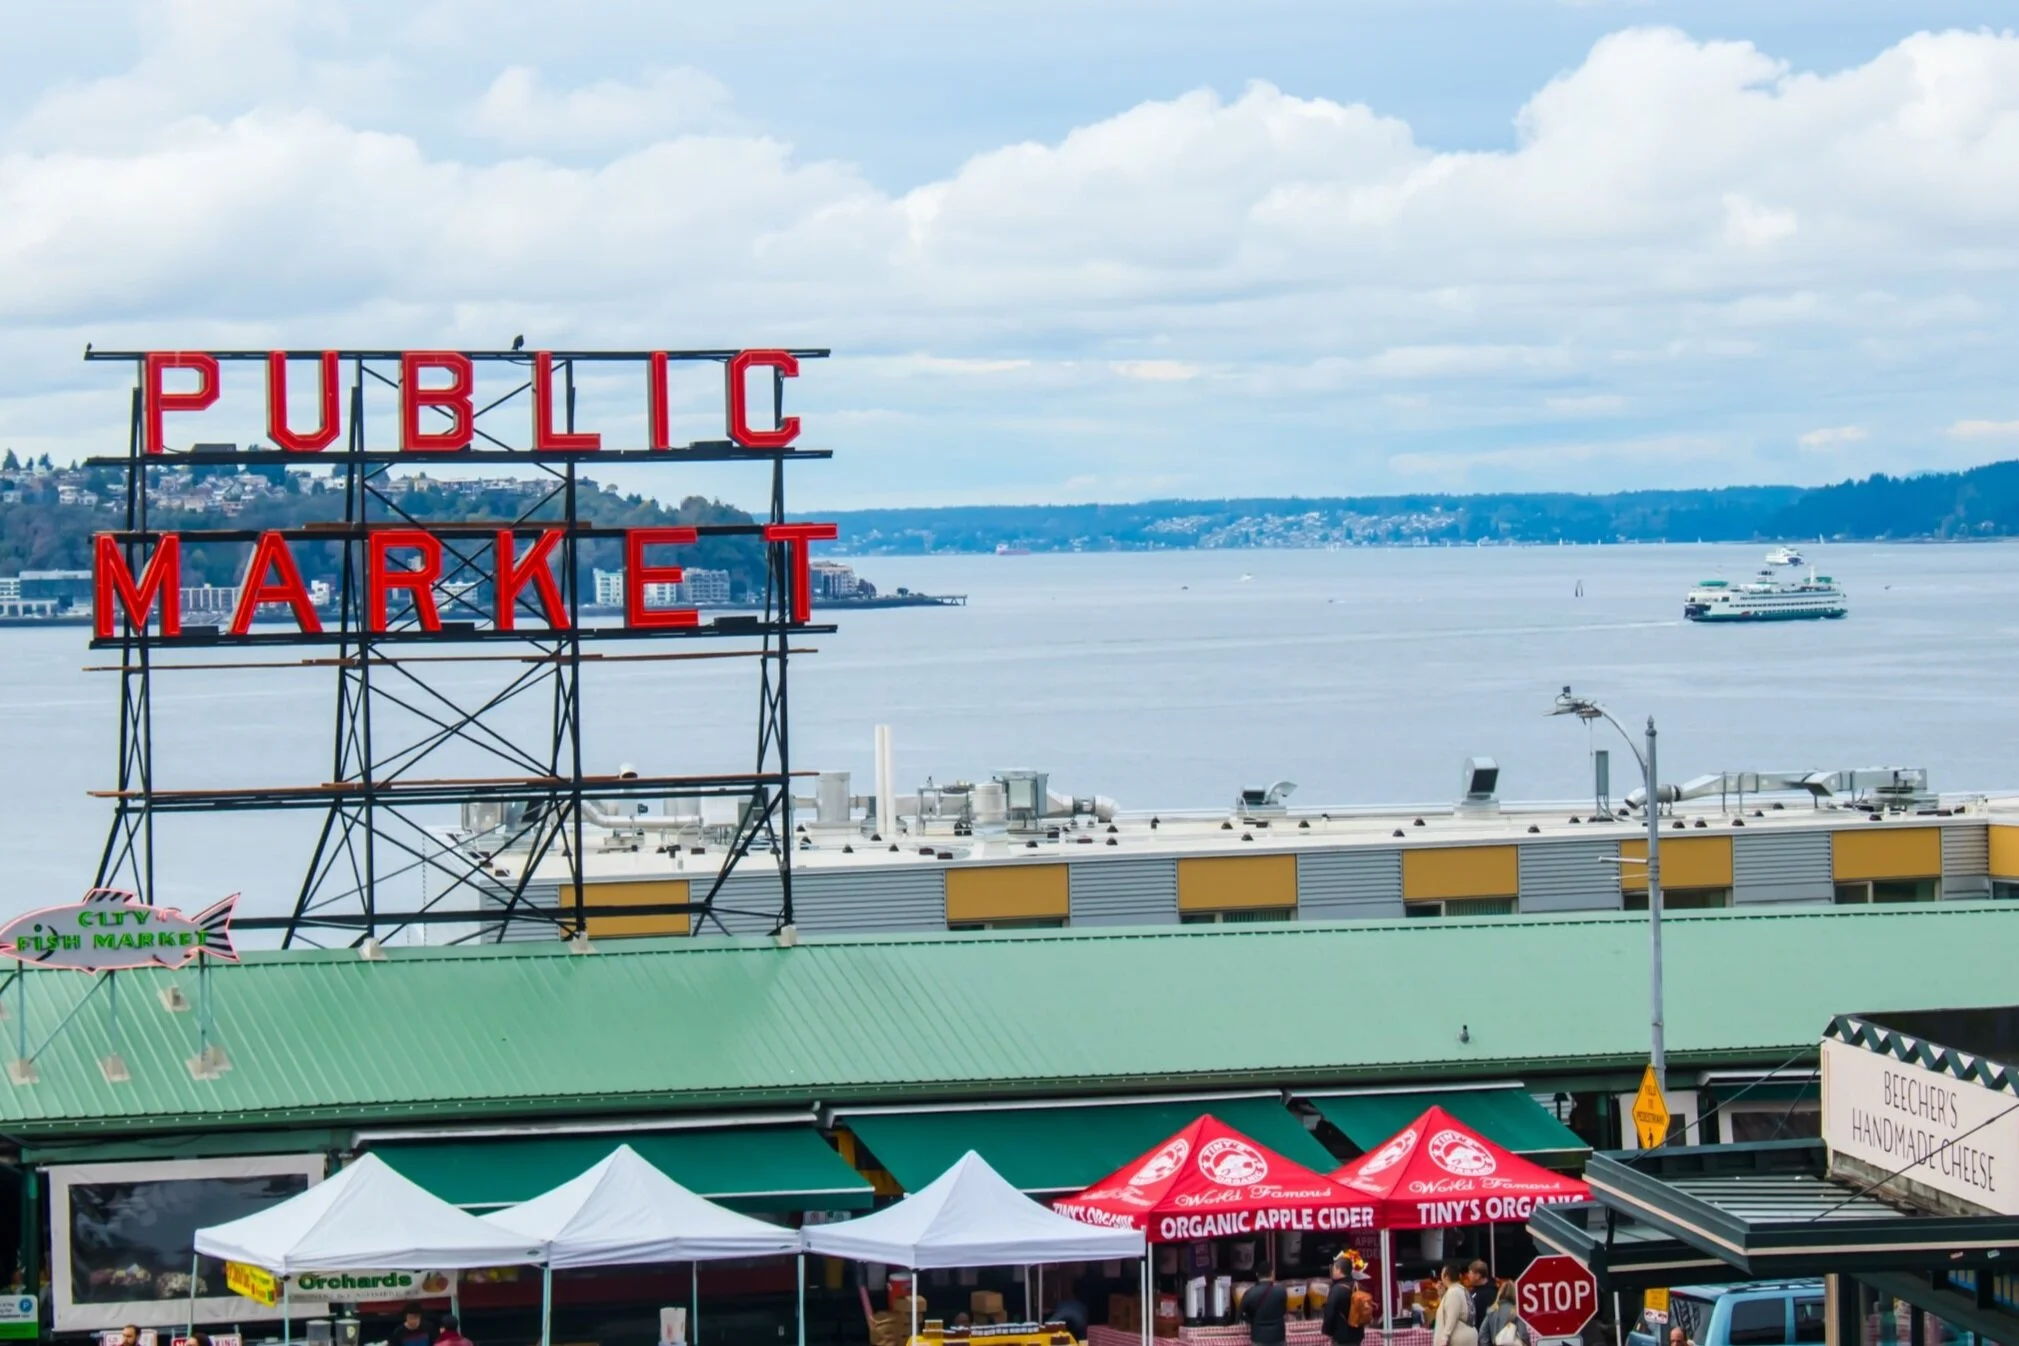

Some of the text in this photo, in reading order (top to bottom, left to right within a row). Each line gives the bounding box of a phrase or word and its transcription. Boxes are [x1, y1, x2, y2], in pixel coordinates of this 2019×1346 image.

[143, 349, 803, 455] PUBLIC
[91, 522, 839, 639] MARKET
[77, 910, 151, 928] CITY
[17, 930, 209, 952] FISH MARKET
[1884, 1070, 1958, 1129] BEECHER'S
[1852, 1107, 1996, 1192] HANDMADE CHEESE
[1175, 1190, 1243, 1207] World
[1249, 1184, 1332, 1199] Famous
[1409, 1177, 1560, 1194] World Famous
[1161, 1206, 1373, 1239] ORGANIC APPLE CIDER
[1417, 1194, 1584, 1224] TINY'S ORGA
[299, 1272, 412, 1290] Orchards
[1522, 1280, 1590, 1313] STOP
